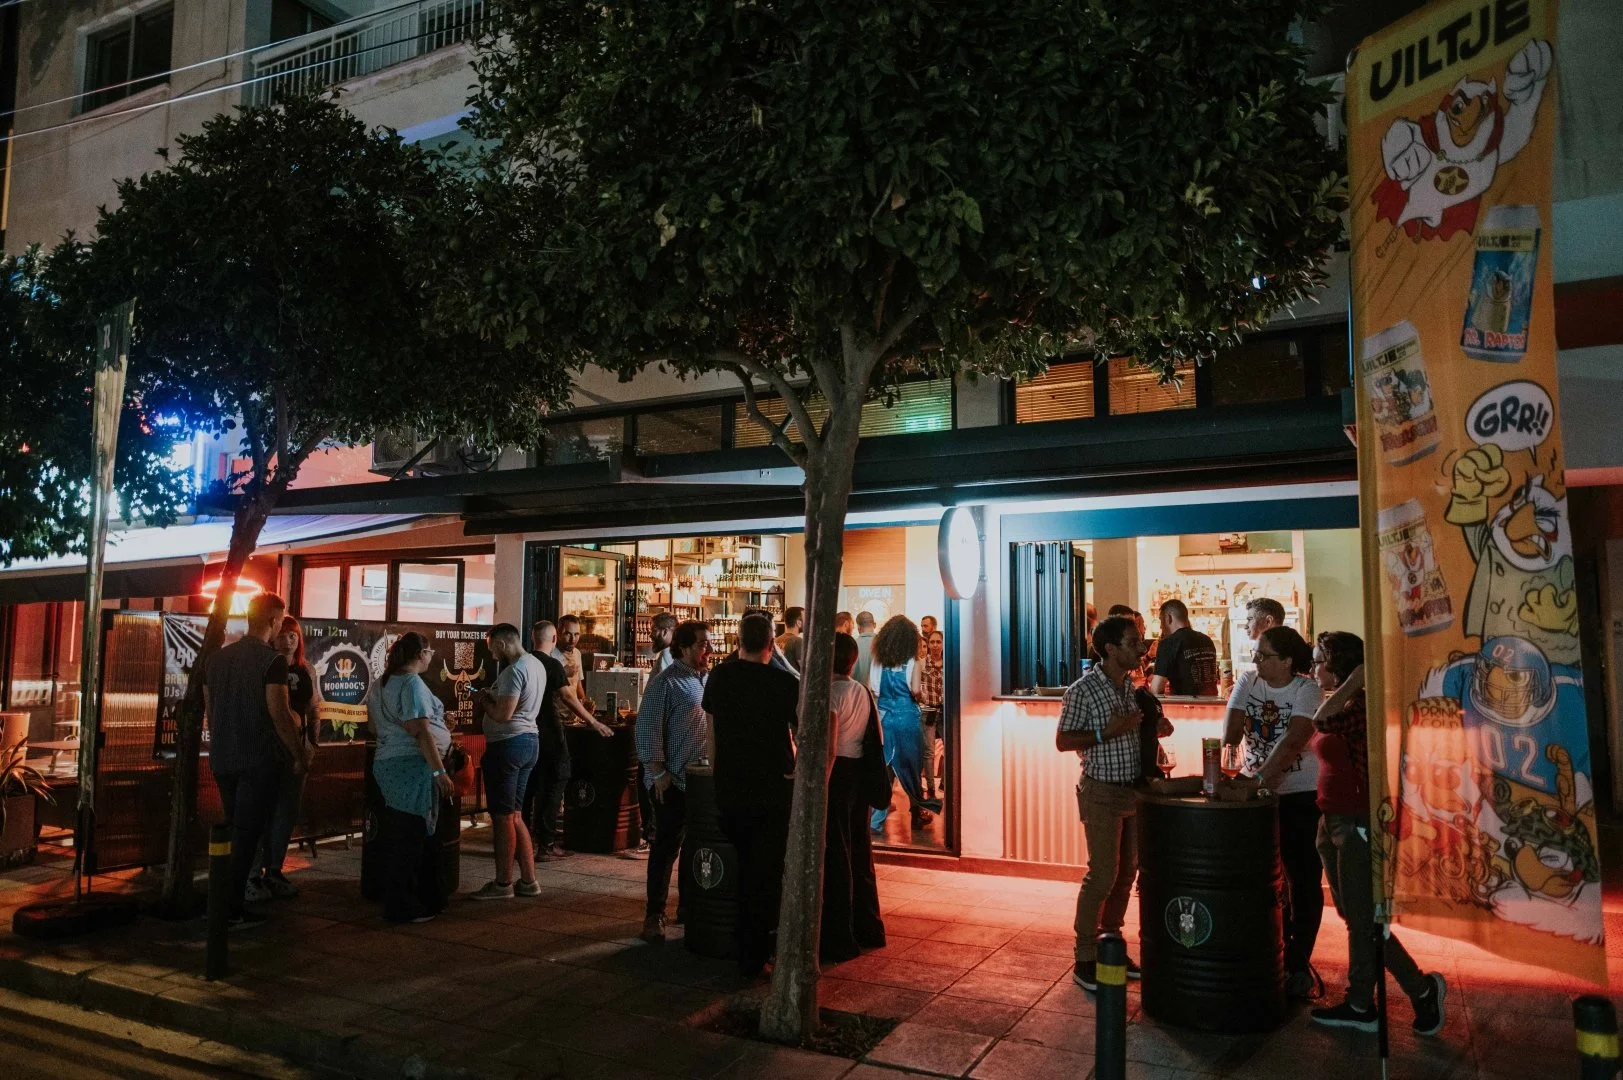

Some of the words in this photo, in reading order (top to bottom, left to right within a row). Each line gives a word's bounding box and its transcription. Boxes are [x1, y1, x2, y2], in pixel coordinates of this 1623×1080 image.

[1370, 0, 1530, 101] UILTJE
[1474, 396, 1549, 437] GRR!!
[328, 625, 348, 637] 12TH
[435, 630, 446, 639] BUY
[446, 630, 460, 640] YOUR
[460, 631, 480, 640] TICKETS
[324, 681, 365, 692] MOONDOG'S
[458, 700, 474, 710] BER
[1421, 706, 1459, 718] DRINK
